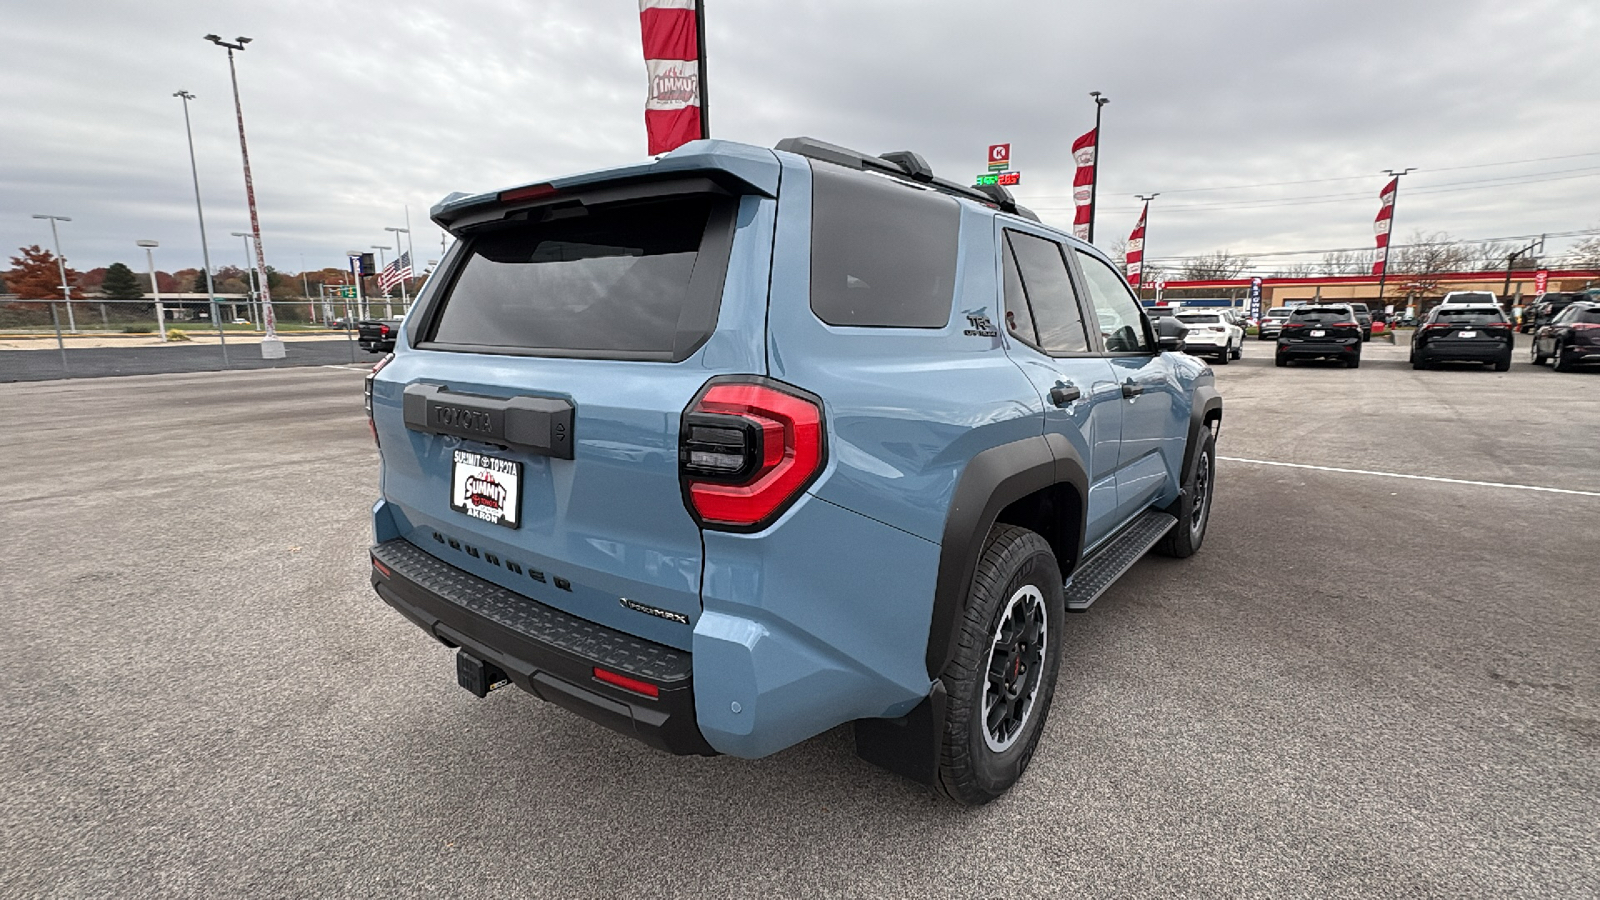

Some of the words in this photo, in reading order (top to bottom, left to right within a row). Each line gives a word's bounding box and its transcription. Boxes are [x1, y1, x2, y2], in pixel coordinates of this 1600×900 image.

[434, 406, 493, 433] TOYOTA
[454, 450, 480, 467] SUMMIT
[490, 458, 517, 476] TOYOTA
[465, 476, 506, 509] SUMMIT
[467, 507, 498, 524] AKRON
[431, 531, 573, 592] 4RUNNER
